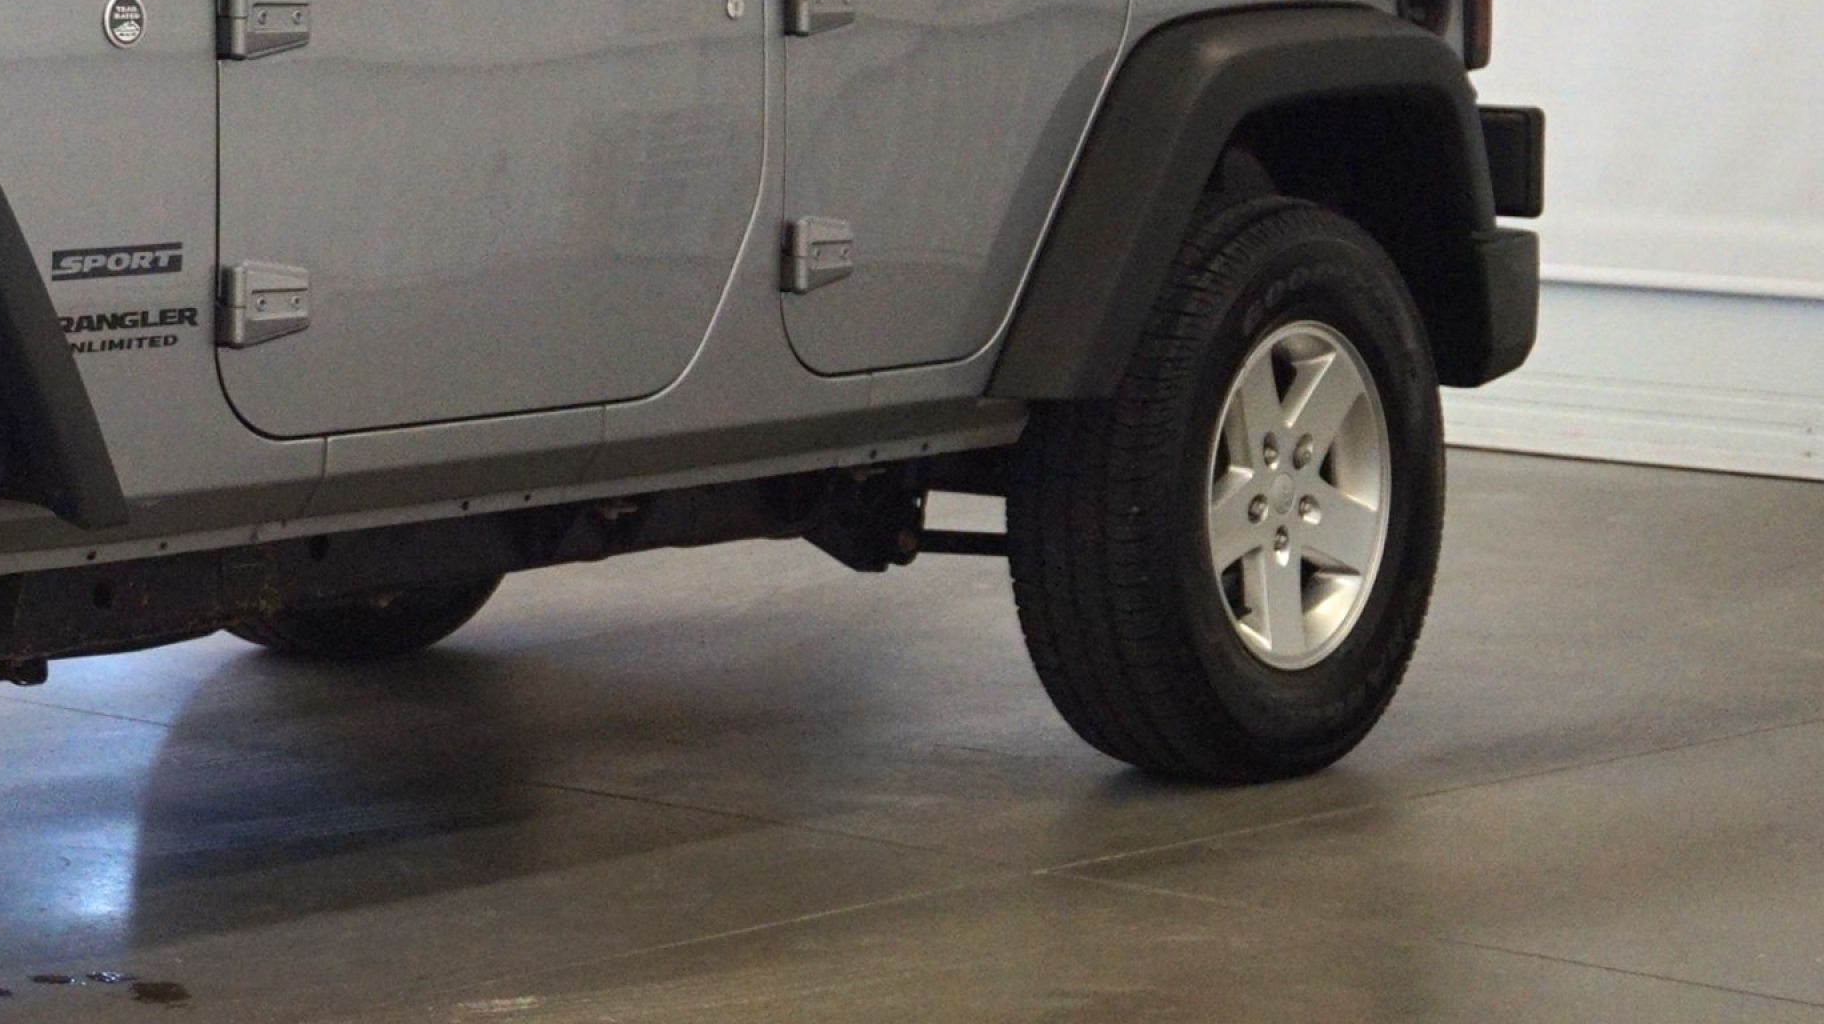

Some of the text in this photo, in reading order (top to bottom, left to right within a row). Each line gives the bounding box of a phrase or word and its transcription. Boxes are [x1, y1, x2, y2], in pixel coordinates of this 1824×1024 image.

[52, 249, 182, 275] SPORT
[58, 307, 199, 334] RANGLER
[70, 334, 178, 354] NLIMITED
